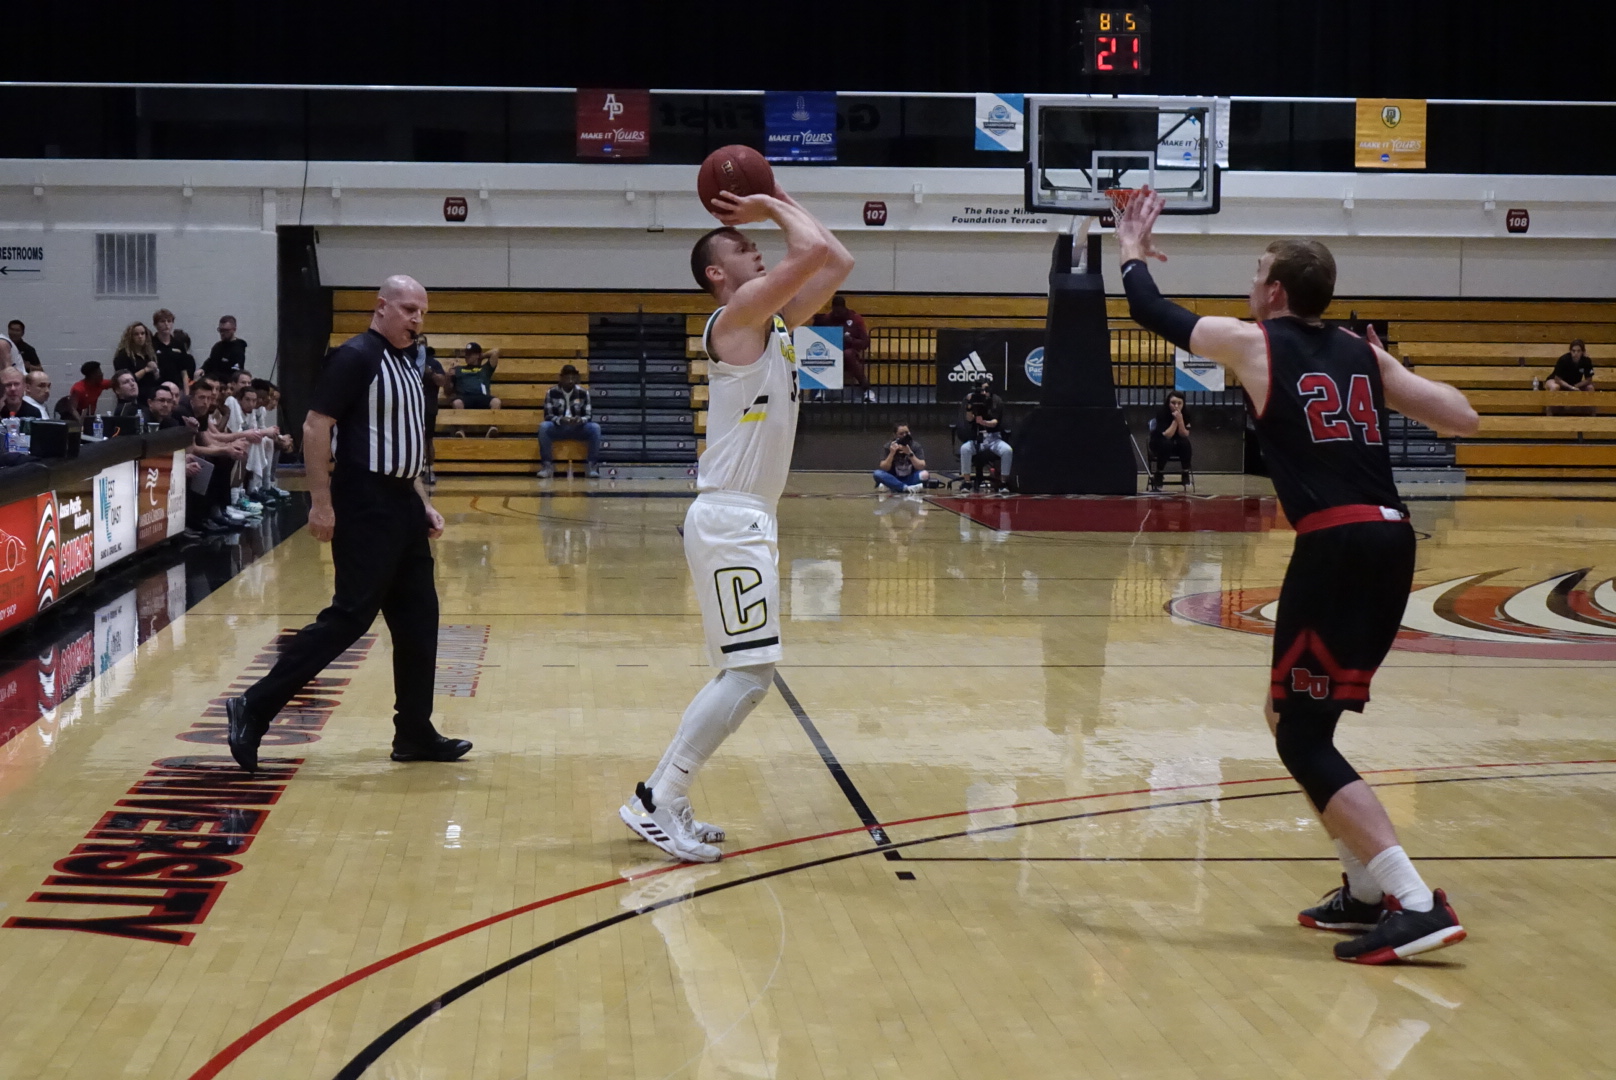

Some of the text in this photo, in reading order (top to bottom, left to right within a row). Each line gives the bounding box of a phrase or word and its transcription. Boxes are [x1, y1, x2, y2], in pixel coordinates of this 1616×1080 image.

[1100, 13, 1136, 30] 8 5
[1097, 37, 1139, 70] 21
[602, 93, 624, 121] AP
[580, 132, 604, 140] MAKE
[612, 127, 645, 143] YOURS
[768, 129, 833, 145] MAKE IT YOURS
[1359, 141, 1381, 149] MAKE
[446, 205, 466, 216] 106
[866, 210, 886, 220] 107
[964, 207, 982, 215] The
[985, 207, 1010, 215] Rose
[951, 216, 1048, 224] Foundation Terrace
[1509, 217, 1528, 227] 108
[947, 370, 993, 382] adidas
[1296, 371, 1383, 446] 24
[60, 530, 93, 586] COUGARS
[714, 566, 768, 636] C
[1, 755, 305, 947] UNIVERSITY
